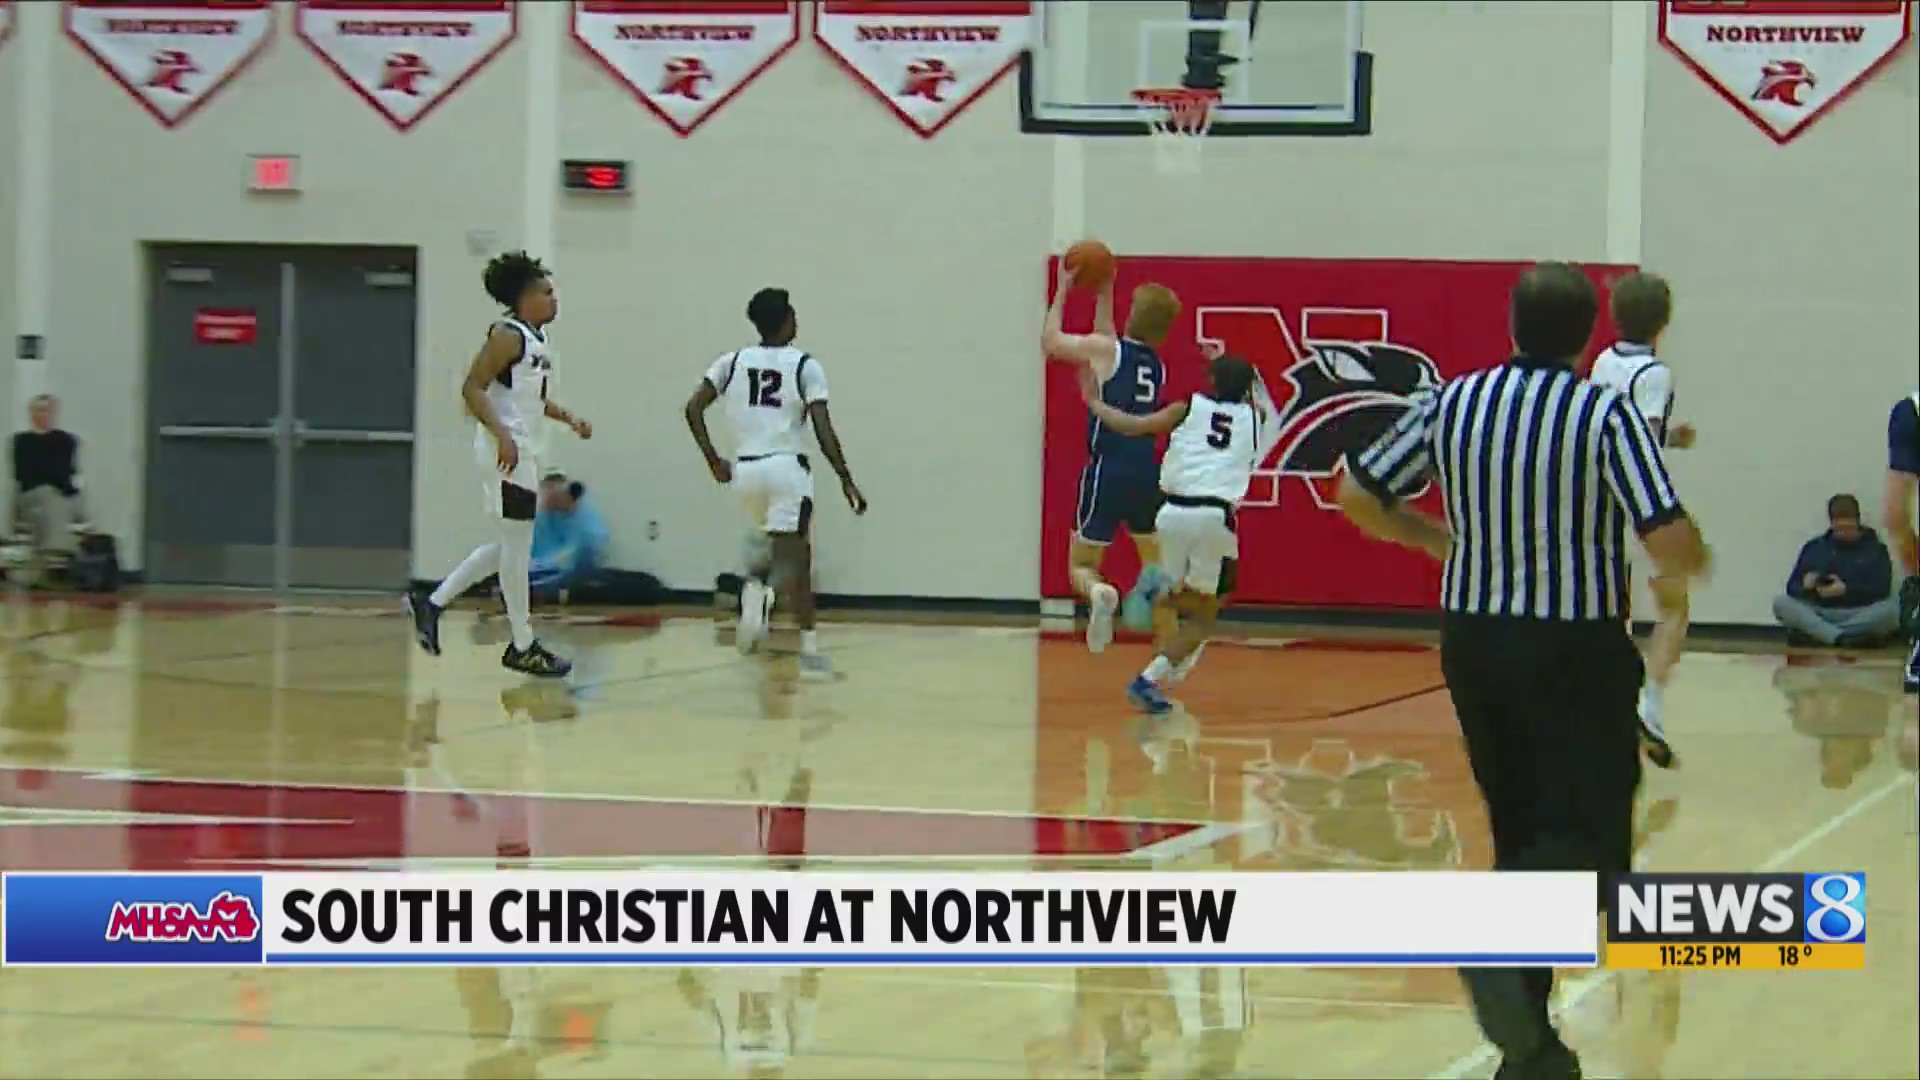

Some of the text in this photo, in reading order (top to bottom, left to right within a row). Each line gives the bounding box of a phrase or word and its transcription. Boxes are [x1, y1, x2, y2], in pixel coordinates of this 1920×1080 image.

[1706, 25, 1865, 43] NORTHVIEW
[747, 367, 782, 409] 12
[1135, 365, 1155, 403] 5
[1206, 411, 1233, 449] 5
